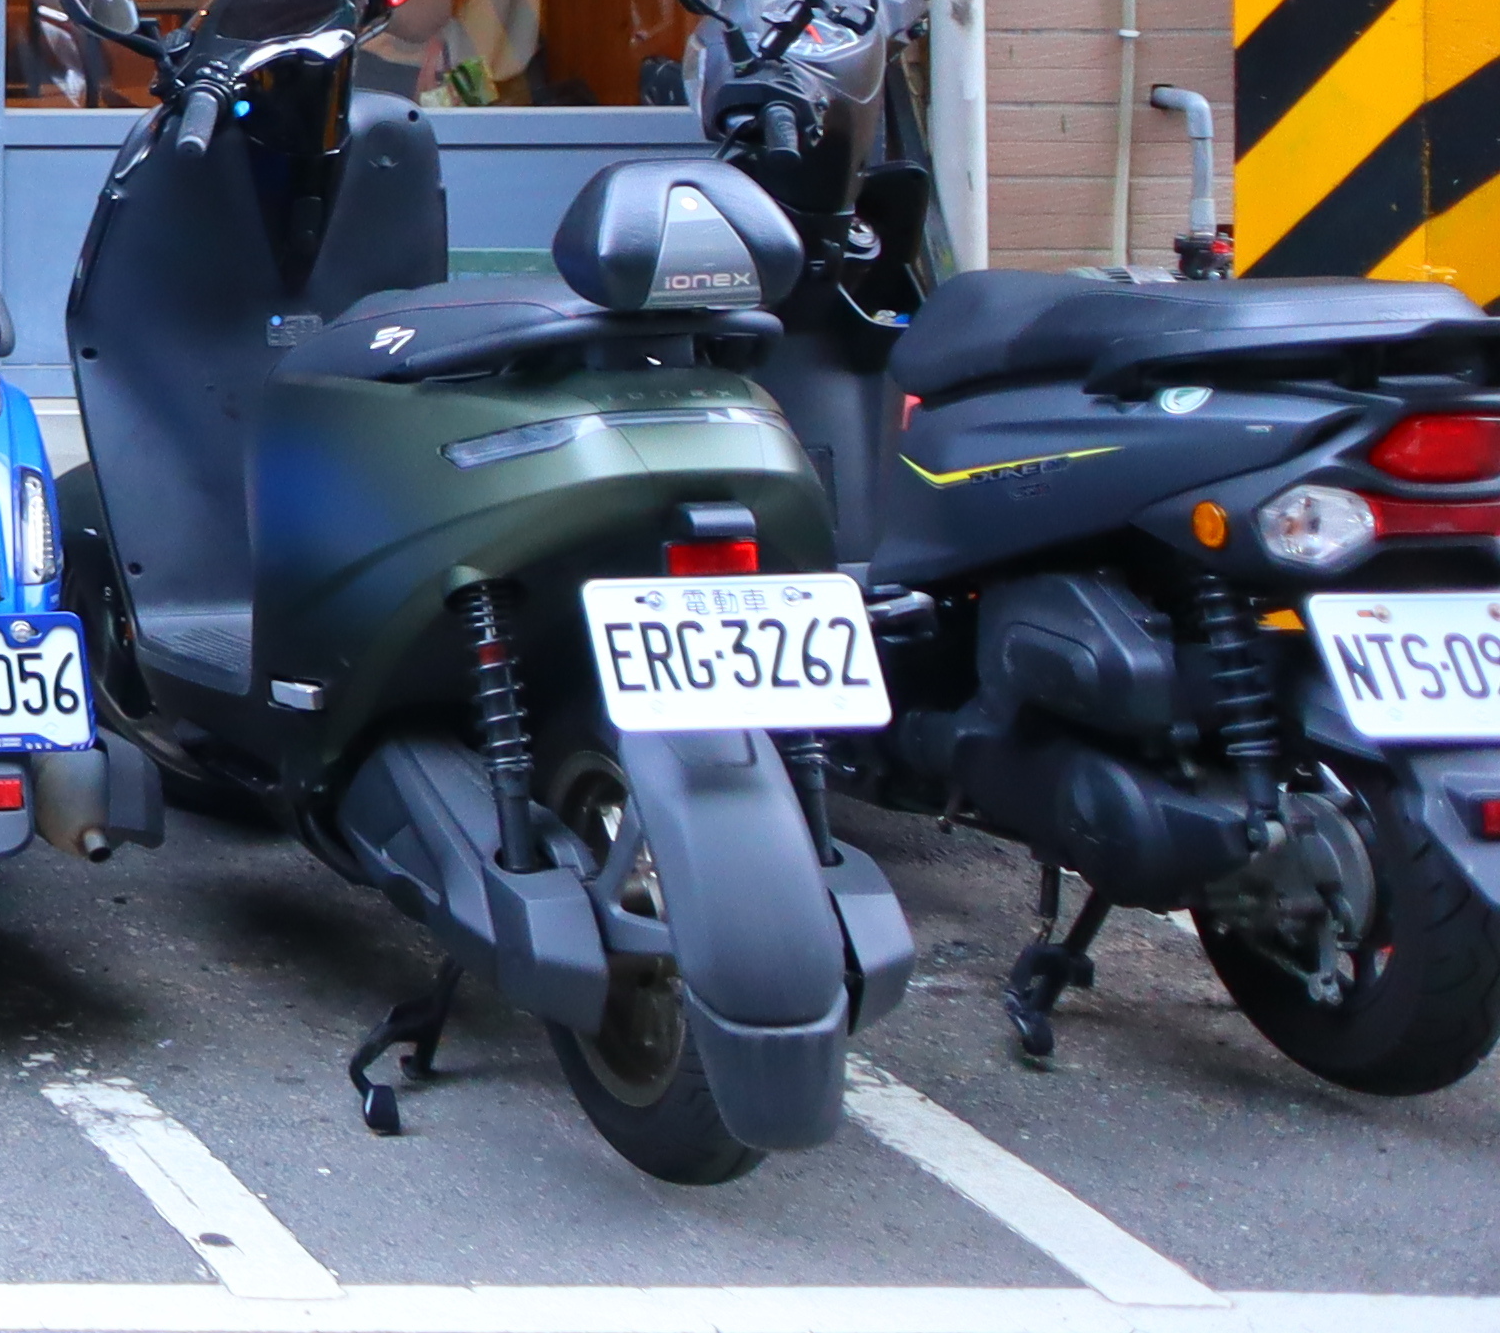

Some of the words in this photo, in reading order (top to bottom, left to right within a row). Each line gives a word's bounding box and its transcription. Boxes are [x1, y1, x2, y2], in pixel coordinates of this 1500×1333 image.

[664, 271, 752, 290] ionex
[370, 326, 416, 355] S7
[682, 589, 768, 615] 電動車
